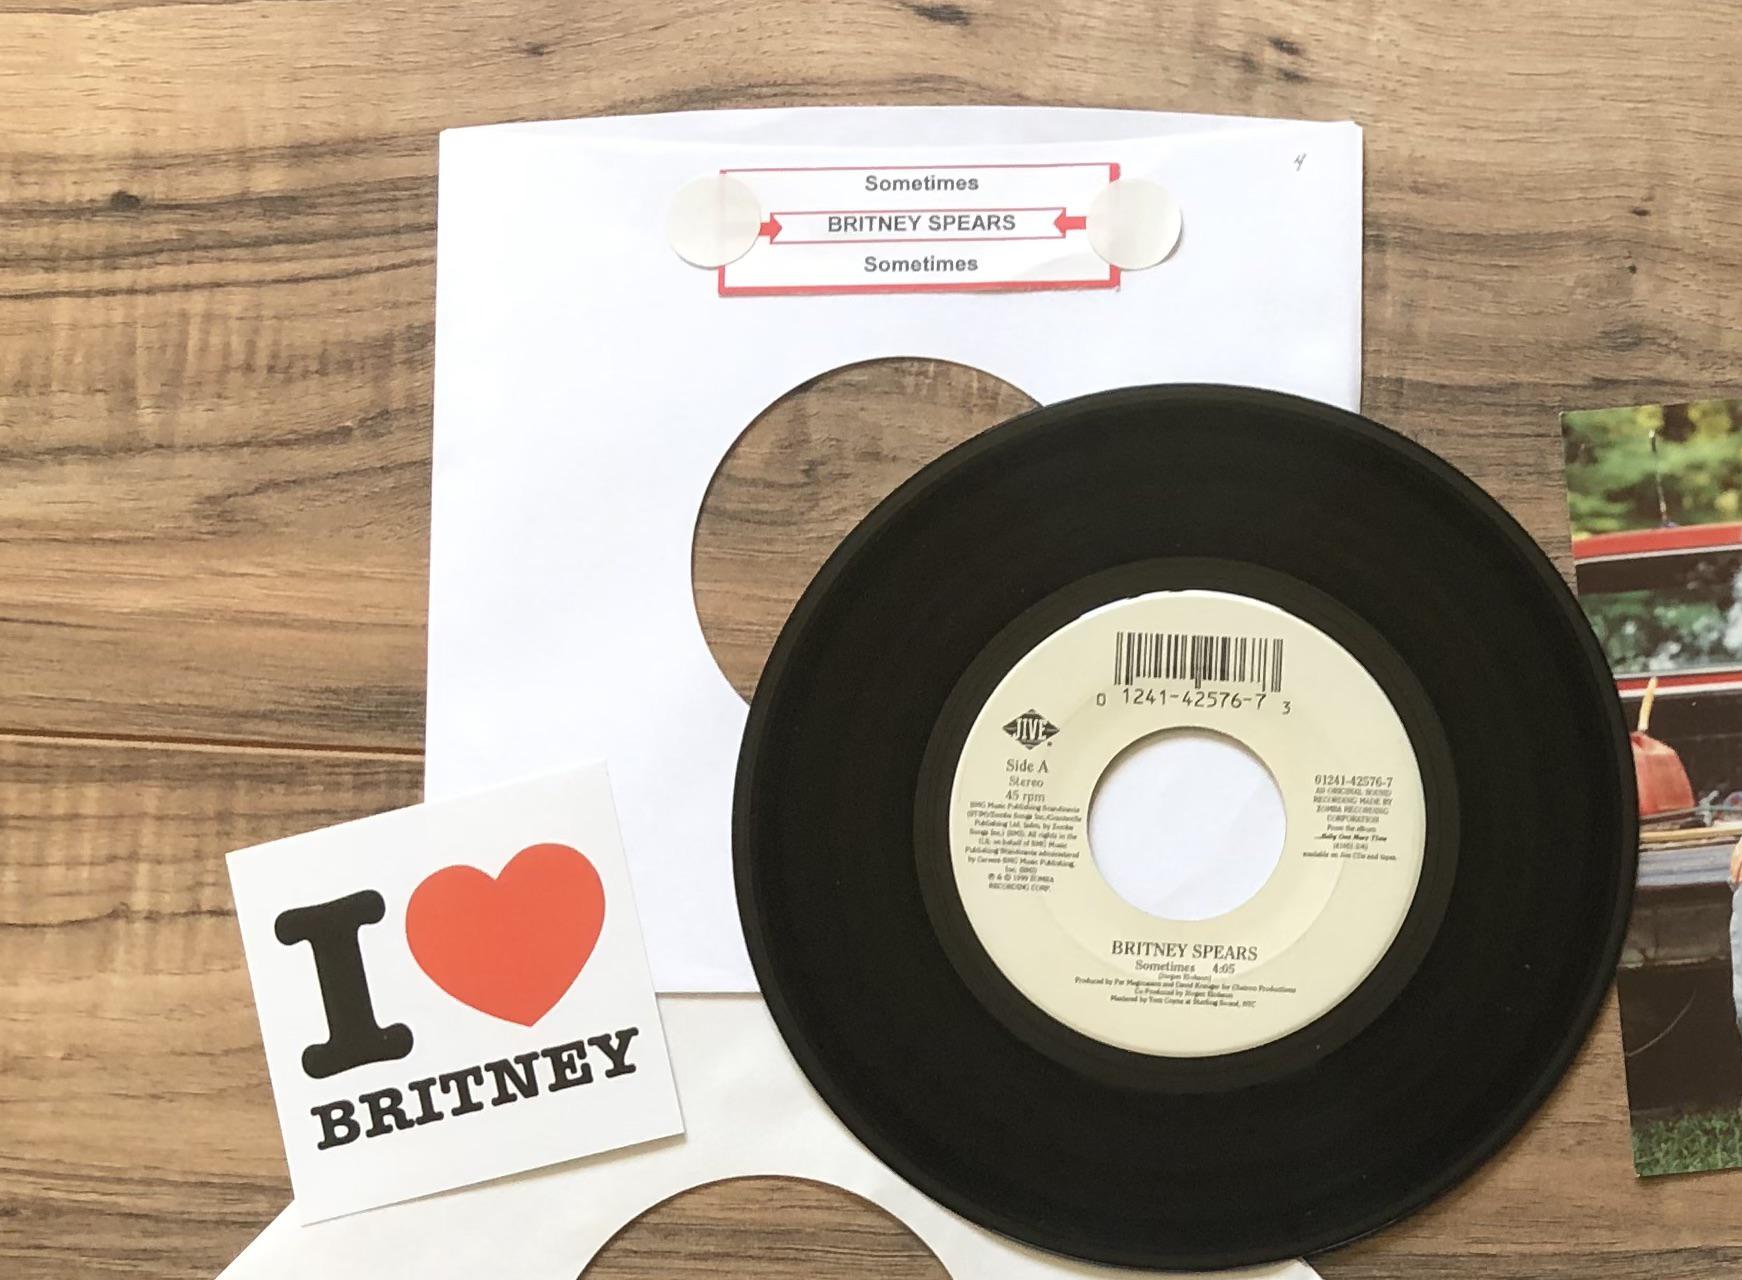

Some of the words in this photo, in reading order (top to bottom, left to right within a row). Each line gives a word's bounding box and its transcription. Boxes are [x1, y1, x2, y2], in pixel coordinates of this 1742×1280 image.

[865, 174, 979, 194] Sometimes
[827, 214, 921, 234] BRITNEY
[928, 213, 1016, 233] SPEARS
[864, 254, 978, 274] Sometimes
[1096, 692, 1107, 707] 0
[1122, 687, 1267, 711] 1241-42576-7
[1281, 700, 1292, 715] 3
[1013, 718, 1048, 741] JIVE
[1006, 758, 1035, 774] Side
[1038, 759, 1049, 774] A
[1008, 775, 1045, 789] Stereo
[1005, 789, 1020, 801] 45
[1022, 791, 1046, 804] rpm
[1111, 939, 1189, 959] BRITNEY
[1192, 943, 1259, 962] SPEARS
[1134, 959, 1196, 973] Sometimes
[273, 888, 415, 1080] I
[310, 1026, 640, 1151] BRITNEY
